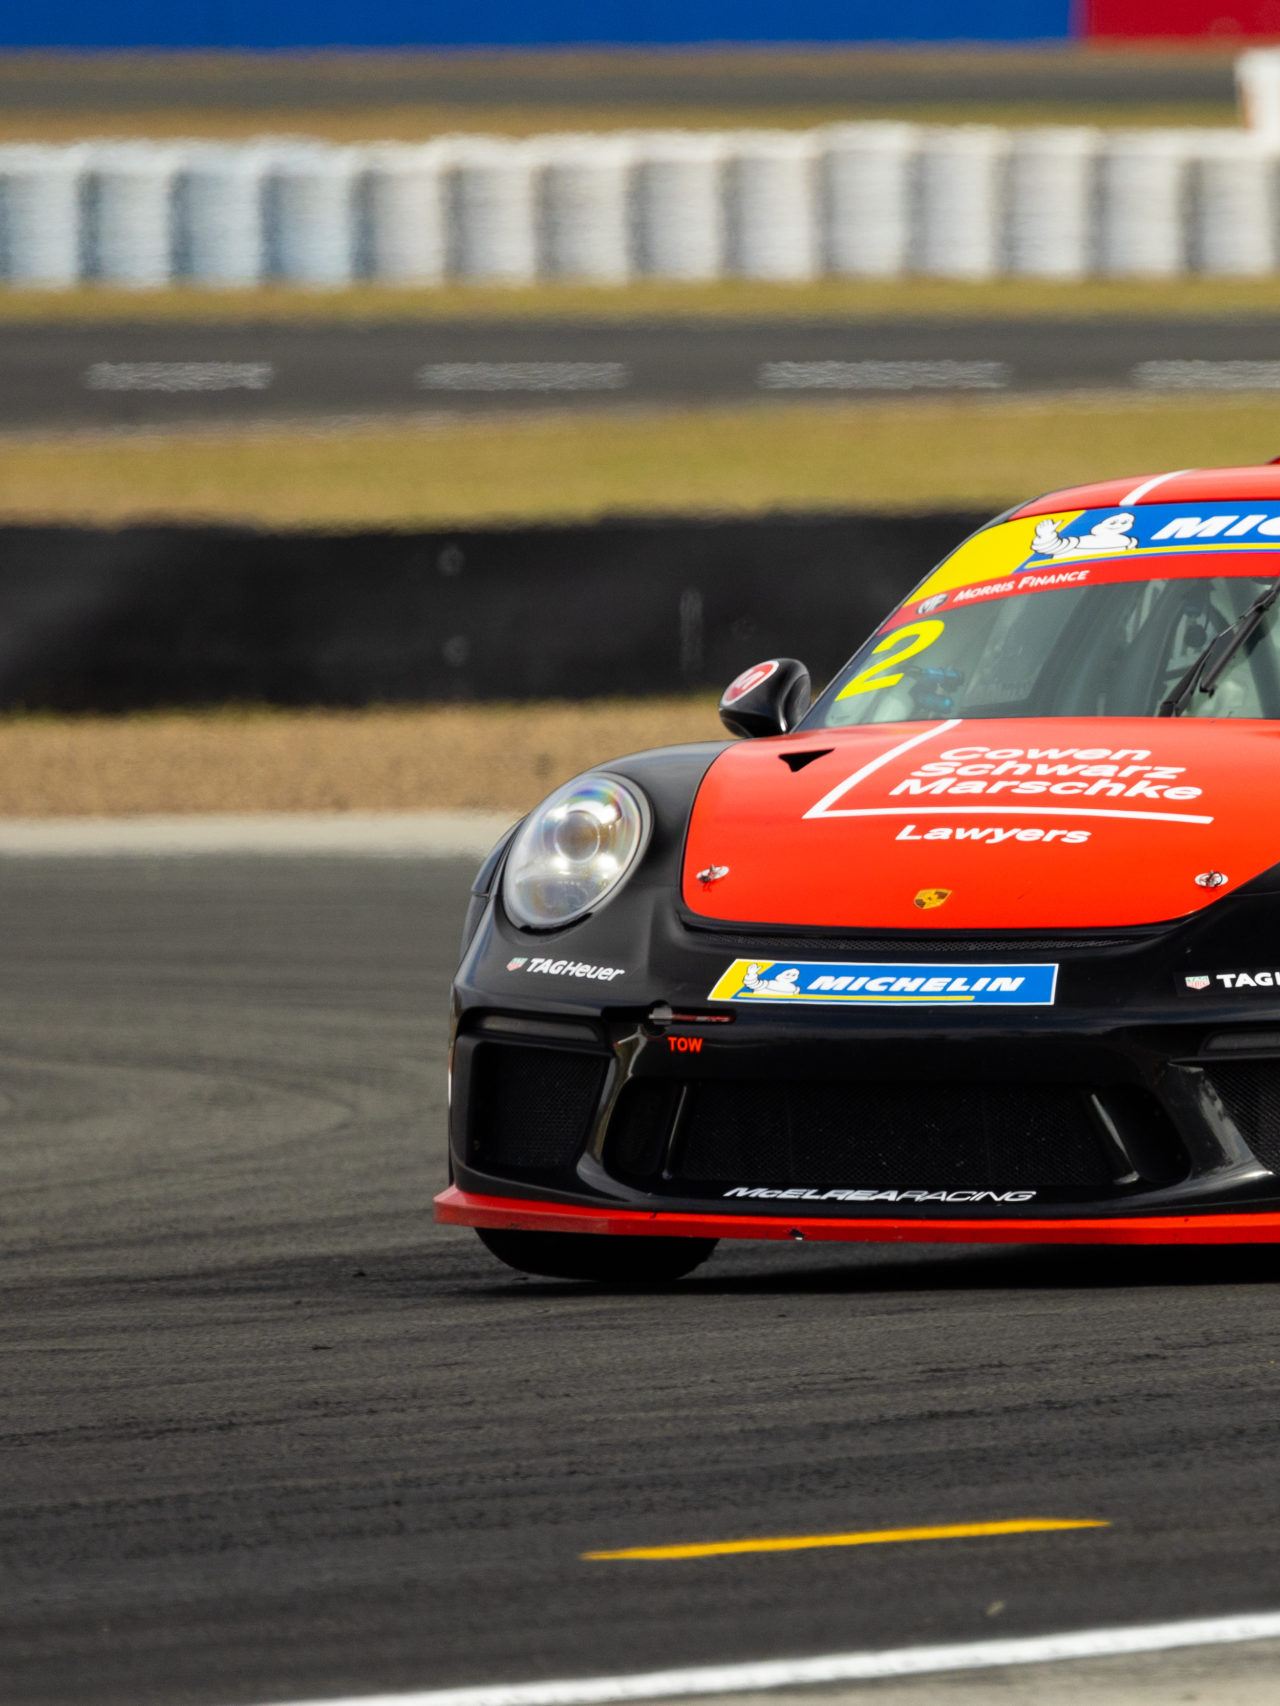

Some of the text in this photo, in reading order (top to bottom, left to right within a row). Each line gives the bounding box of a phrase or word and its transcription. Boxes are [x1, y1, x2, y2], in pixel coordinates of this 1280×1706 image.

[953, 570, 1091, 603] MORRIS FINANCE
[834, 619, 945, 702] 2
[940, 746, 1151, 761] Cowen
[911, 761, 1187, 779] Schwarz
[888, 778, 1203, 800] Marschke
[895, 825, 1092, 844] Lawyers
[807, 975, 1026, 993] MICHELIN
[667, 1037, 703, 1053] TOW
